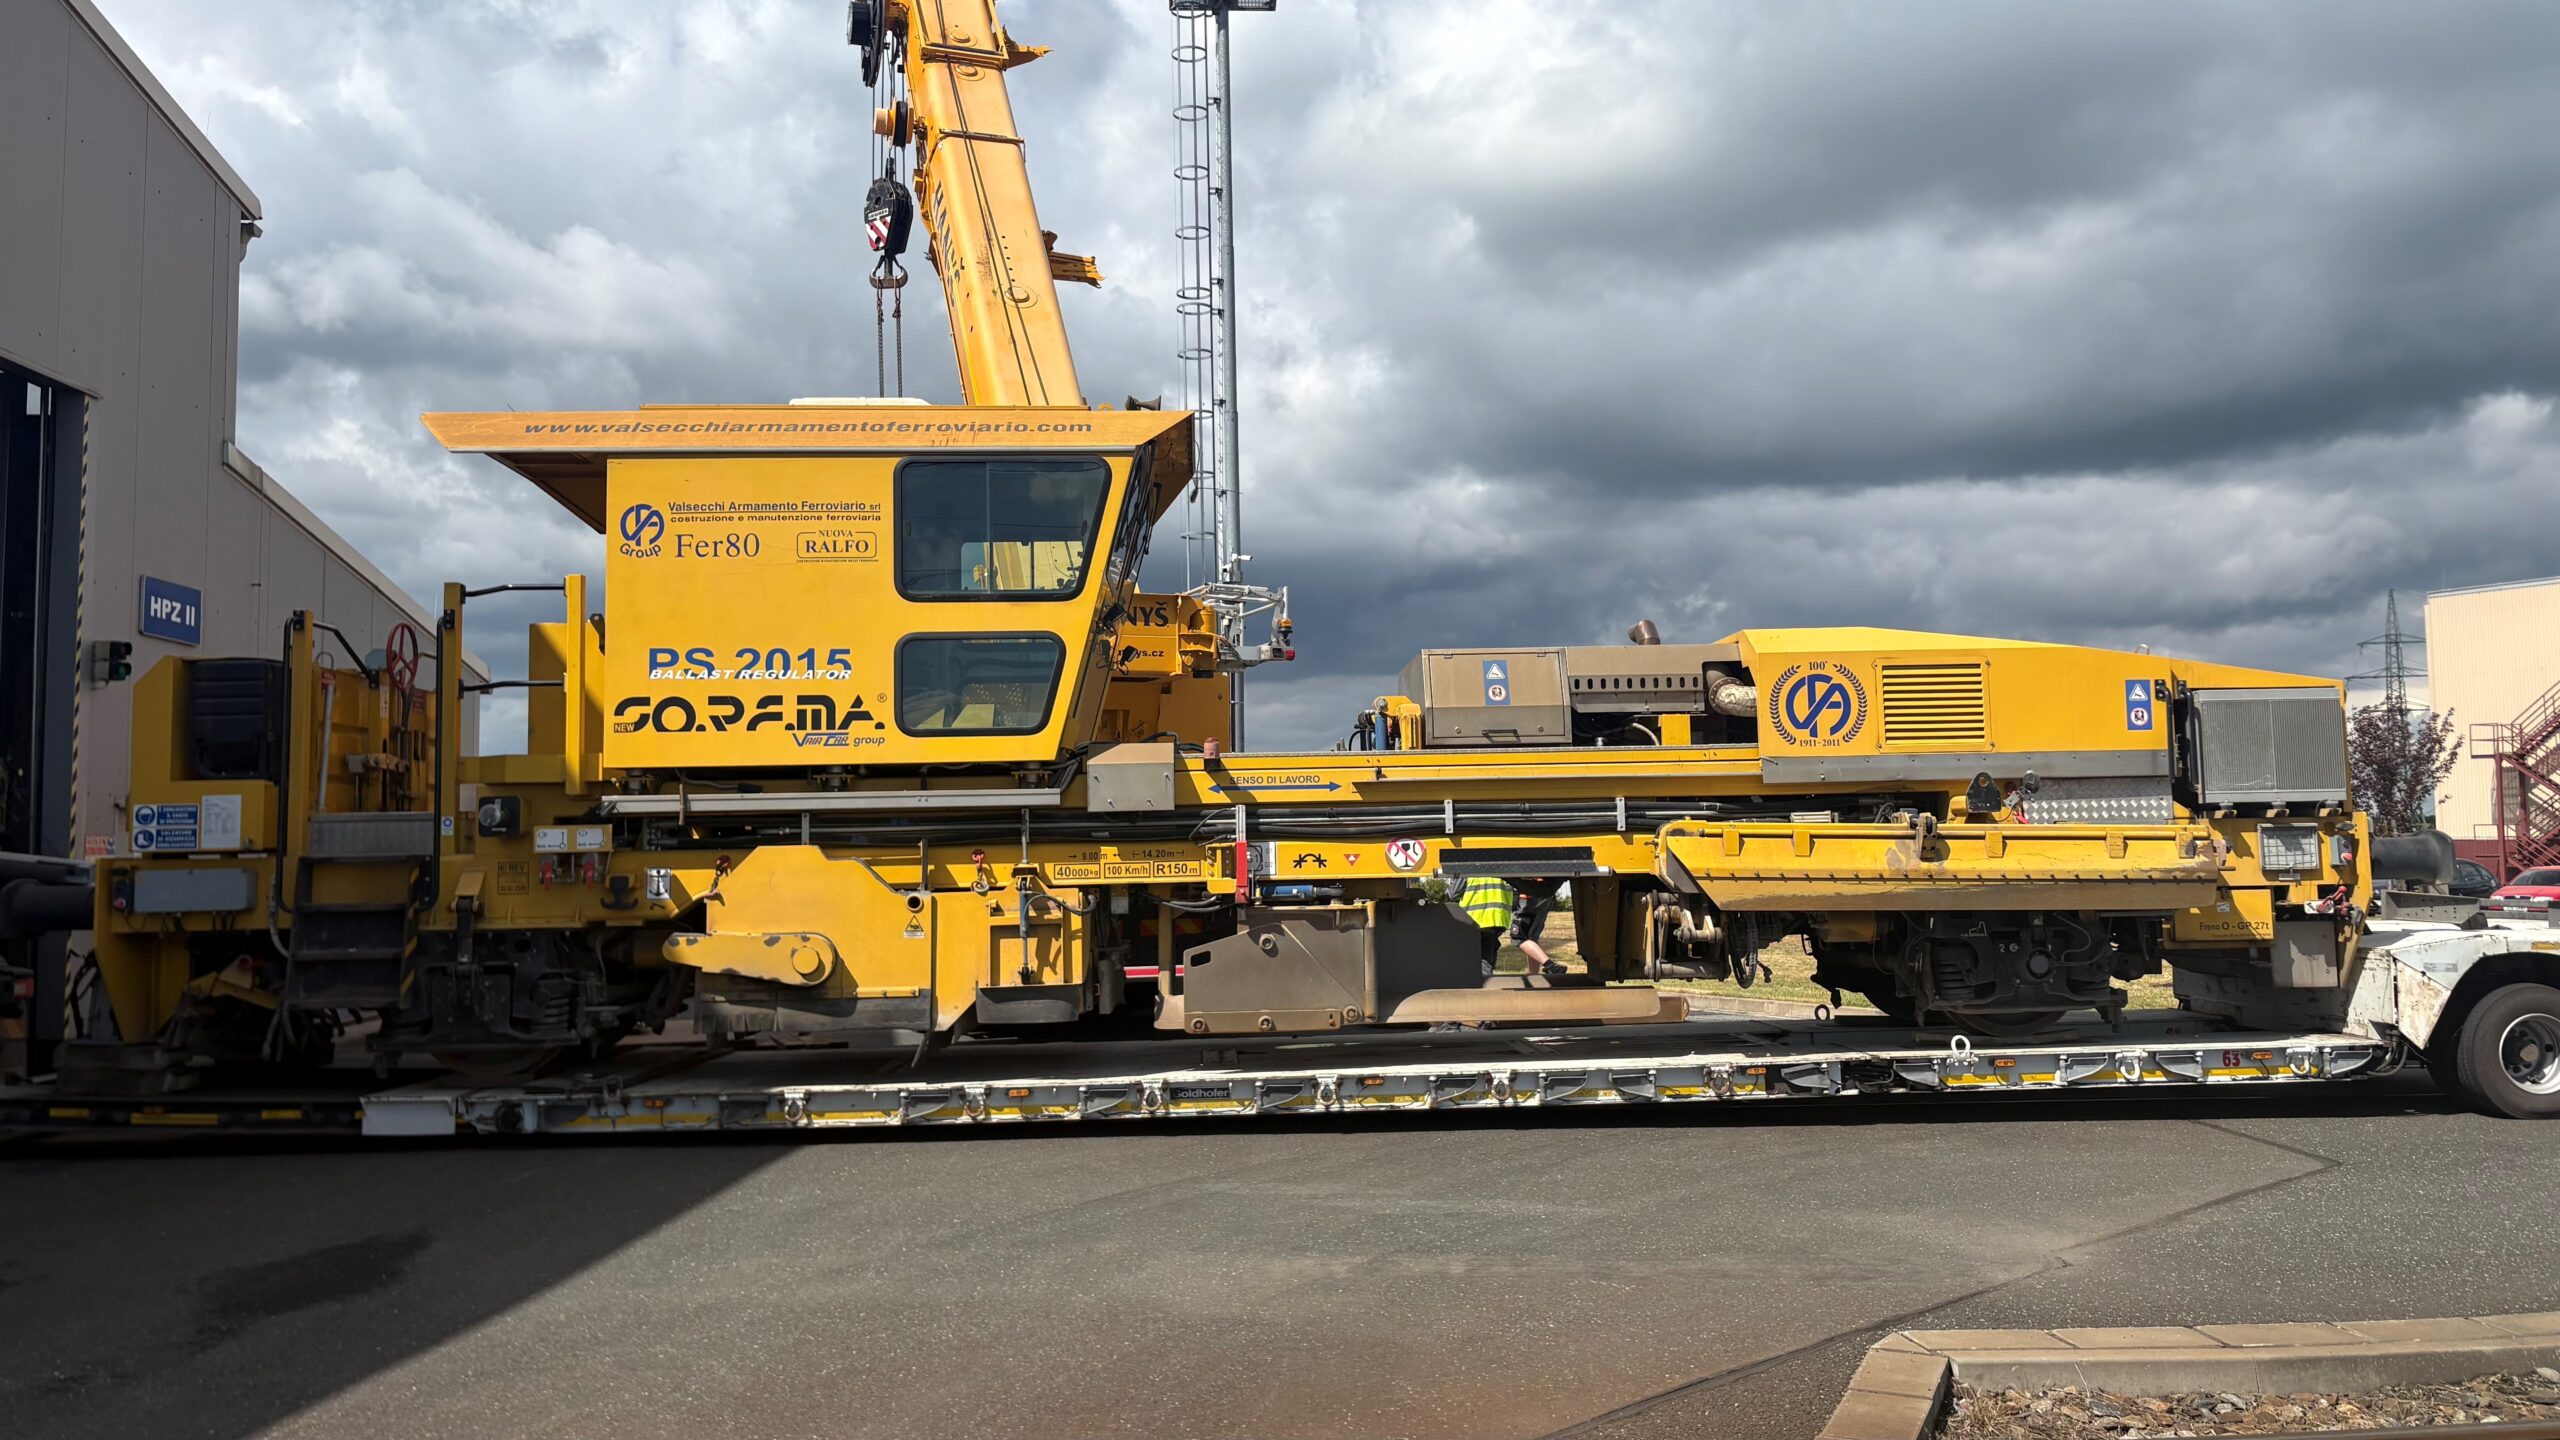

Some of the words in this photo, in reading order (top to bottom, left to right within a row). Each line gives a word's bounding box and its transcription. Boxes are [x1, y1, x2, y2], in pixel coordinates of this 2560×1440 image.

[525, 421, 1092, 433] www.valsecchiarmamentoferroviario.com
[668, 501, 725, 511] Valsecchi
[728, 501, 798, 511] Armamento
[801, 501, 866, 511] Ferroviario
[670, 514, 734, 523] costruzione
[747, 514, 823, 522] manutenzione
[826, 514, 881, 522] ferroviaria
[818, 529, 854, 538] NUOVA
[619, 542, 662, 559] Group
[675, 532, 760, 558] Fer80
[805, 539, 869, 553] RALFO
[150, 595, 182, 624] HPZ
[185, 604, 196, 627] II
[648, 647, 716, 679] PS
[734, 647, 853, 680] 2015
[650, 669, 735, 680] BALLAST
[737, 669, 852, 680] REGULATOR
[614, 722, 635, 733] NEW
[853, 736, 885, 747] group
[1229, 776, 1264, 785] SENSO
[1266, 775, 1277, 784] DI
[1279, 774, 1321, 784] LAVORO
[1106, 865, 1122, 876] 100
[1125, 864, 1149, 876] Km/h
[1156, 862, 1188, 875] R150
[2199, 922, 2221, 931] Freno
[2254, 921, 2270, 931] 27t
[2222, 1050, 2241, 1068] 63
